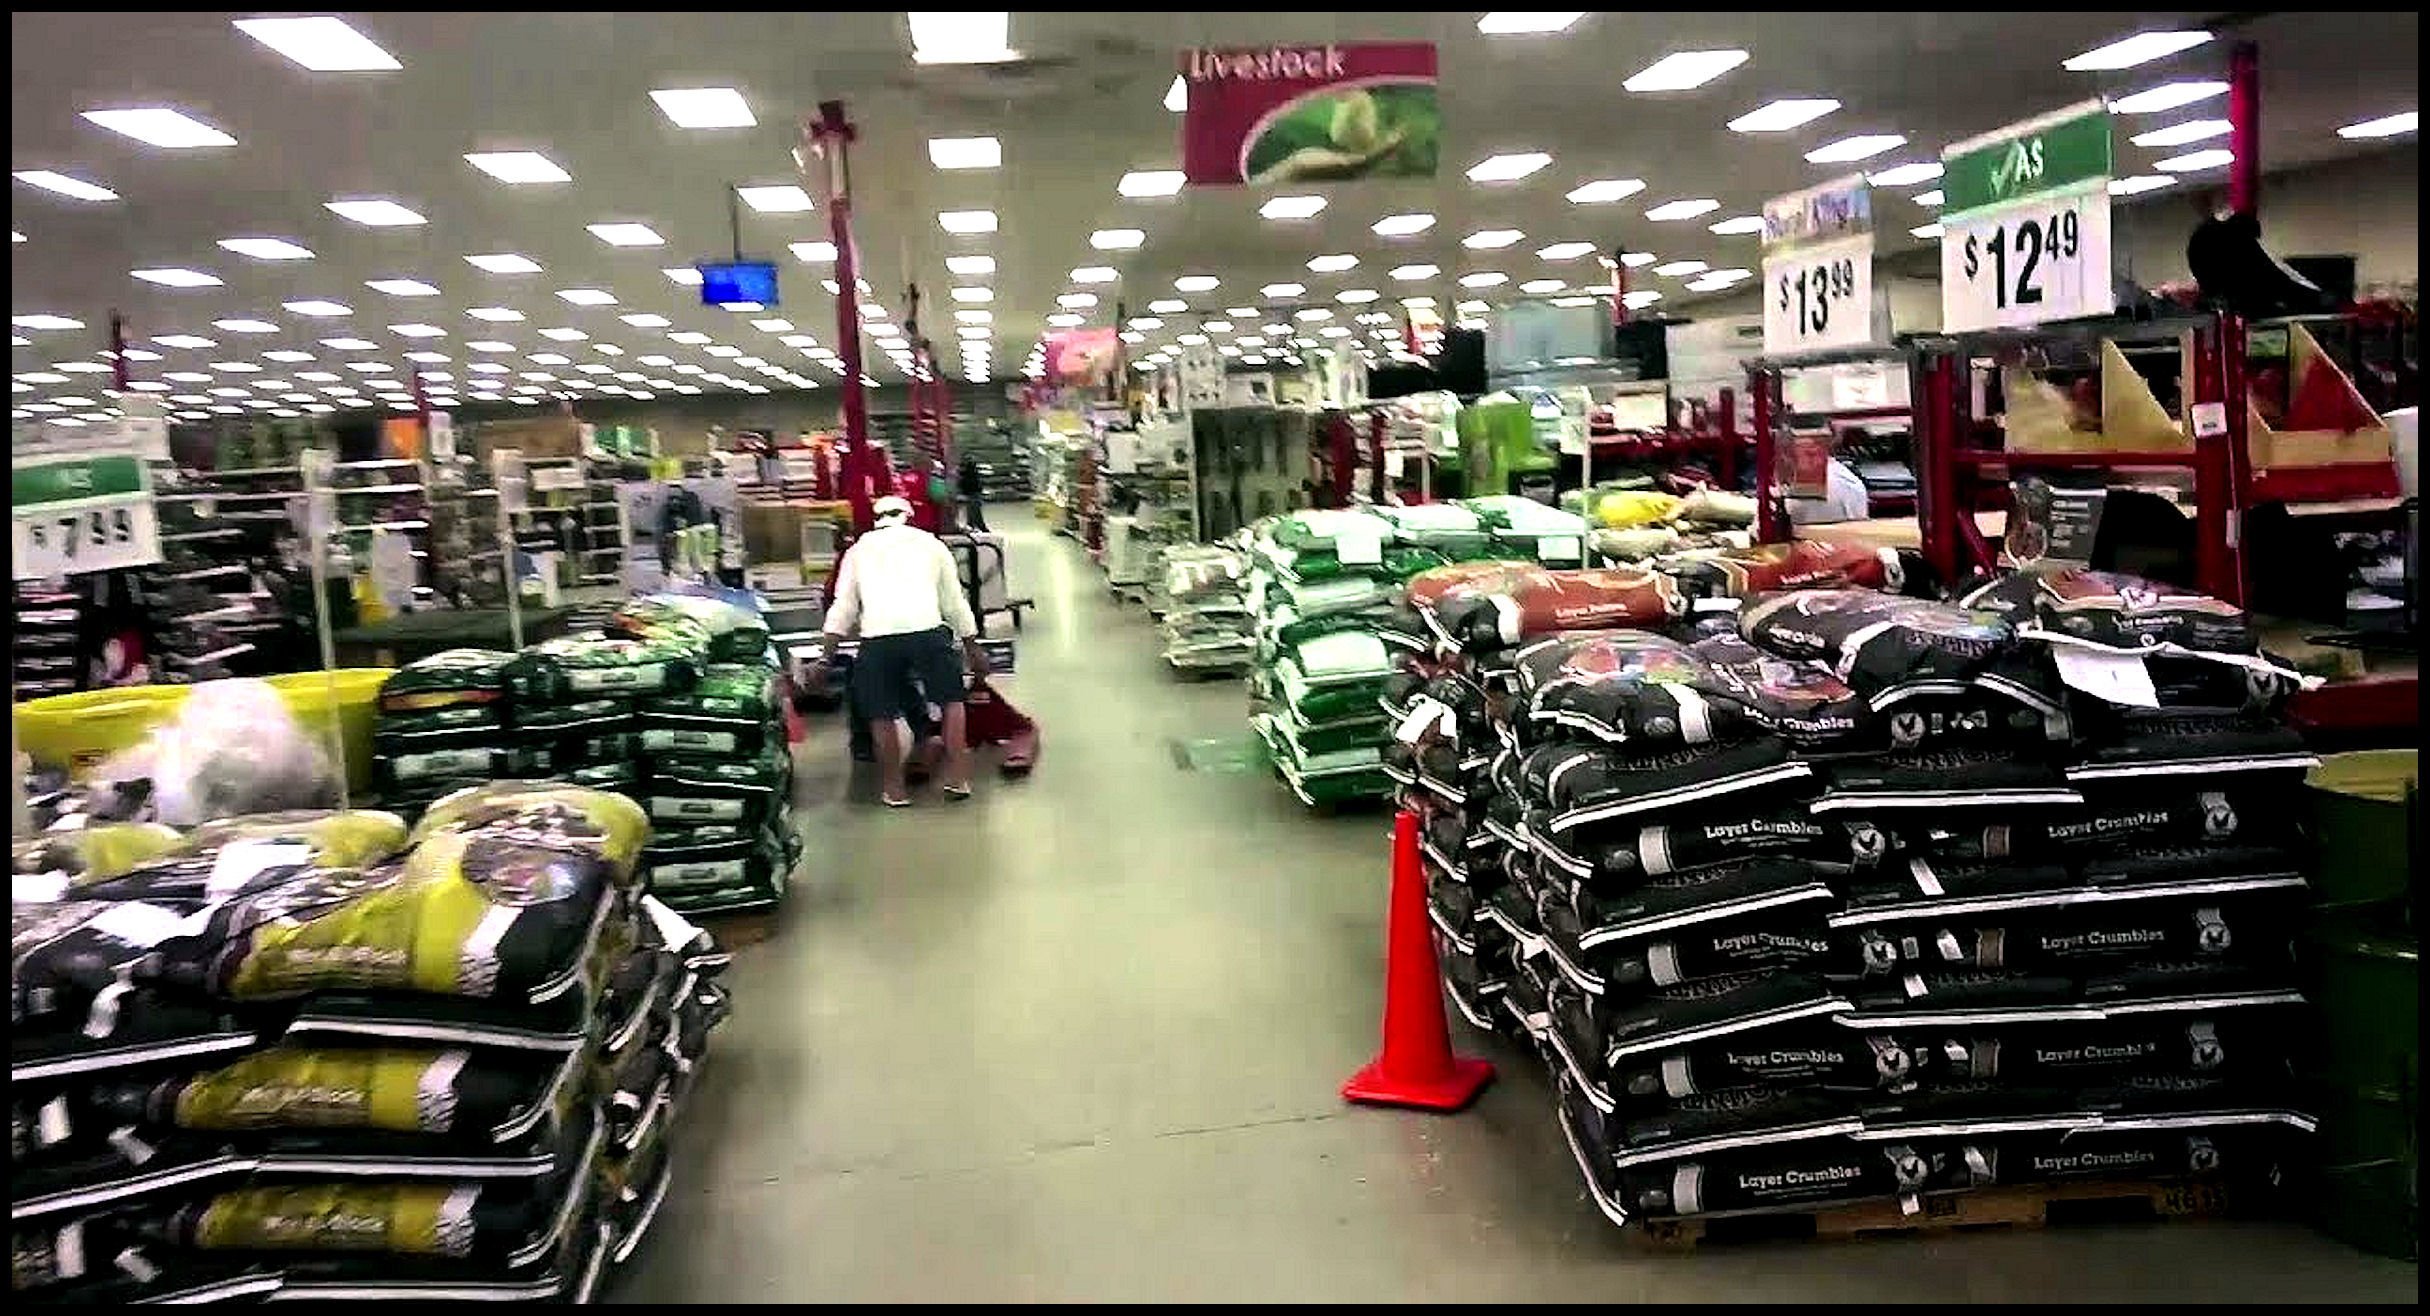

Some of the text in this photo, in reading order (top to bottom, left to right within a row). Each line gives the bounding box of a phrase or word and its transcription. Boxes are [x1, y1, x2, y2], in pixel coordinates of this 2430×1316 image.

[1190, 45, 1346, 81] Livestock
[1704, 823, 1749, 839] Layer
[2047, 821, 2092, 838] Layer
[2041, 928, 2165, 950] Layer Crumbles
[1770, 1050, 1844, 1065] Crumbles
[2035, 1042, 2156, 1063] Layer Crumbls
[2033, 1155, 2078, 1170] Layer
[1739, 1165, 1862, 1189] Layer Crumbles
